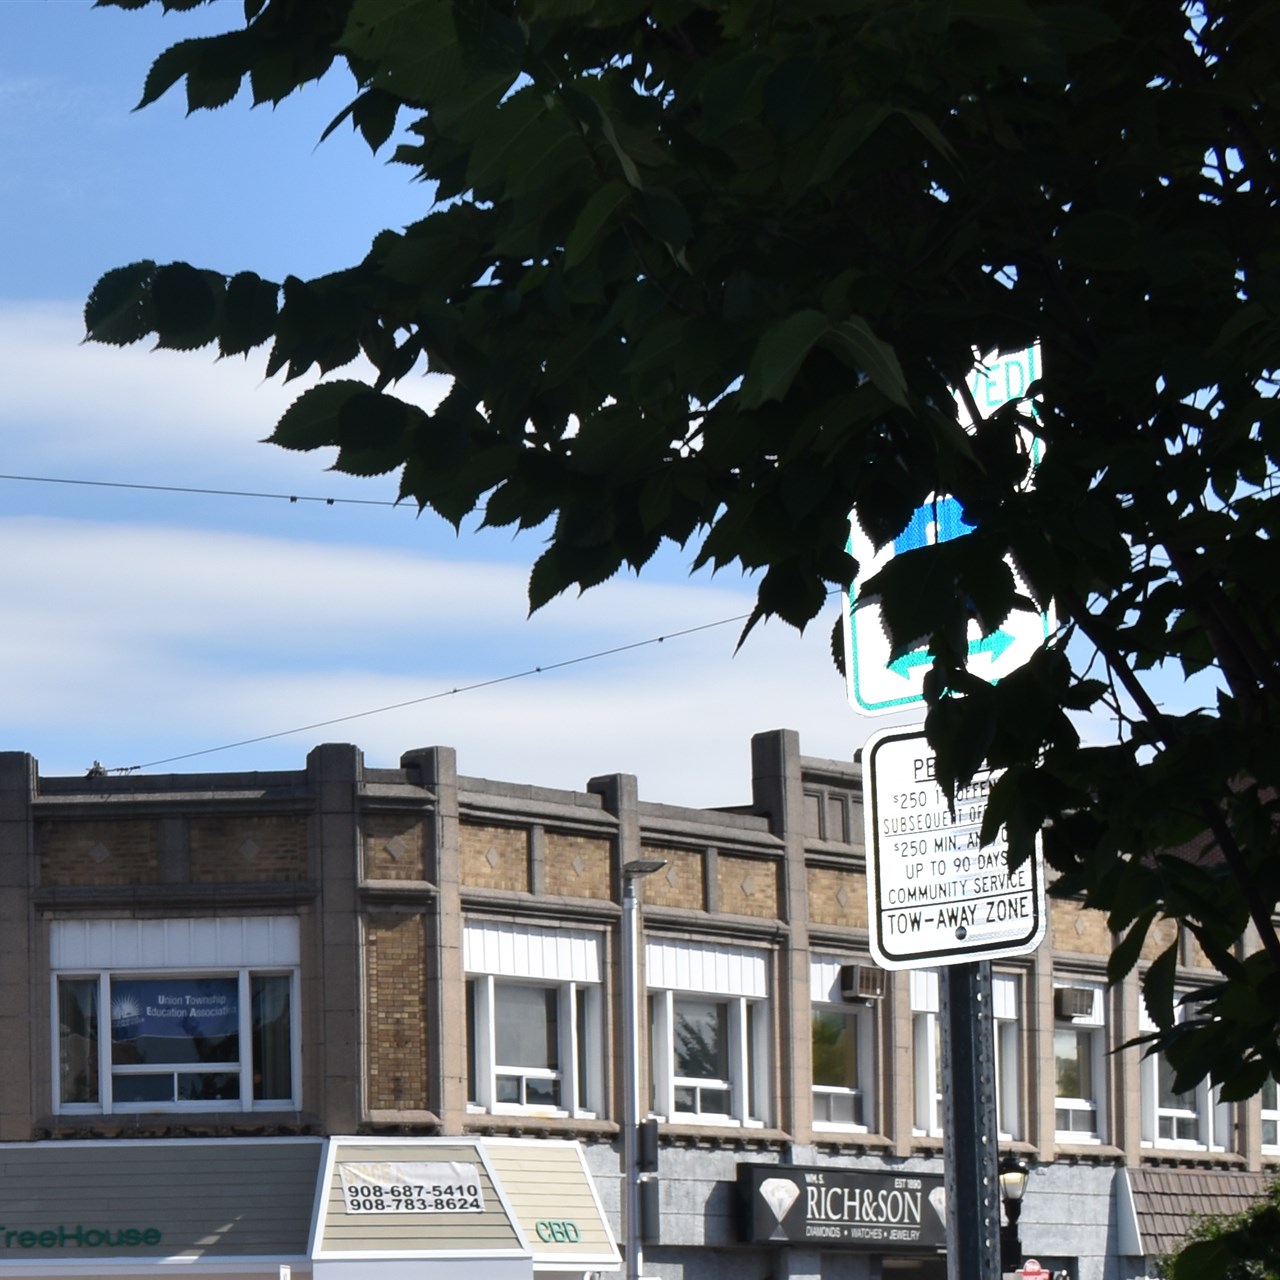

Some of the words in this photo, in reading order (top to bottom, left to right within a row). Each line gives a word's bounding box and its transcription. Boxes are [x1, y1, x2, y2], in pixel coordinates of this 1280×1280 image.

[894, 790, 927, 810] $250
[894, 839, 928, 858] $250
[934, 836, 961, 853] MIN.
[906, 863, 924, 880] UP
[931, 860, 947, 876] TO
[953, 856, 971, 873] 90
[977, 850, 1008, 870] DAYS
[888, 880, 967, 905] COMMUNITY
[973, 871, 1026, 894] SERVICE
[887, 903, 977, 936] TOW-AWAY
[986, 896, 1030, 923] ZONE
[158, 995, 183, 1004] Union
[185, 995, 226, 1006] Township
[146, 1006, 188, 1017] Education
[347, 1184, 478, 1199] 908-687-5410
[349, 1197, 481, 1212] 908-783-8624
[806, 1186, 922, 1223] RICH&SON
[535, 1219, 581, 1243] CBD
[806, 1226, 841, 1238] DIAMONDS
[850, 1227, 883, 1240] WATCHES
[888, 1229, 921, 1241] JEWELRY
